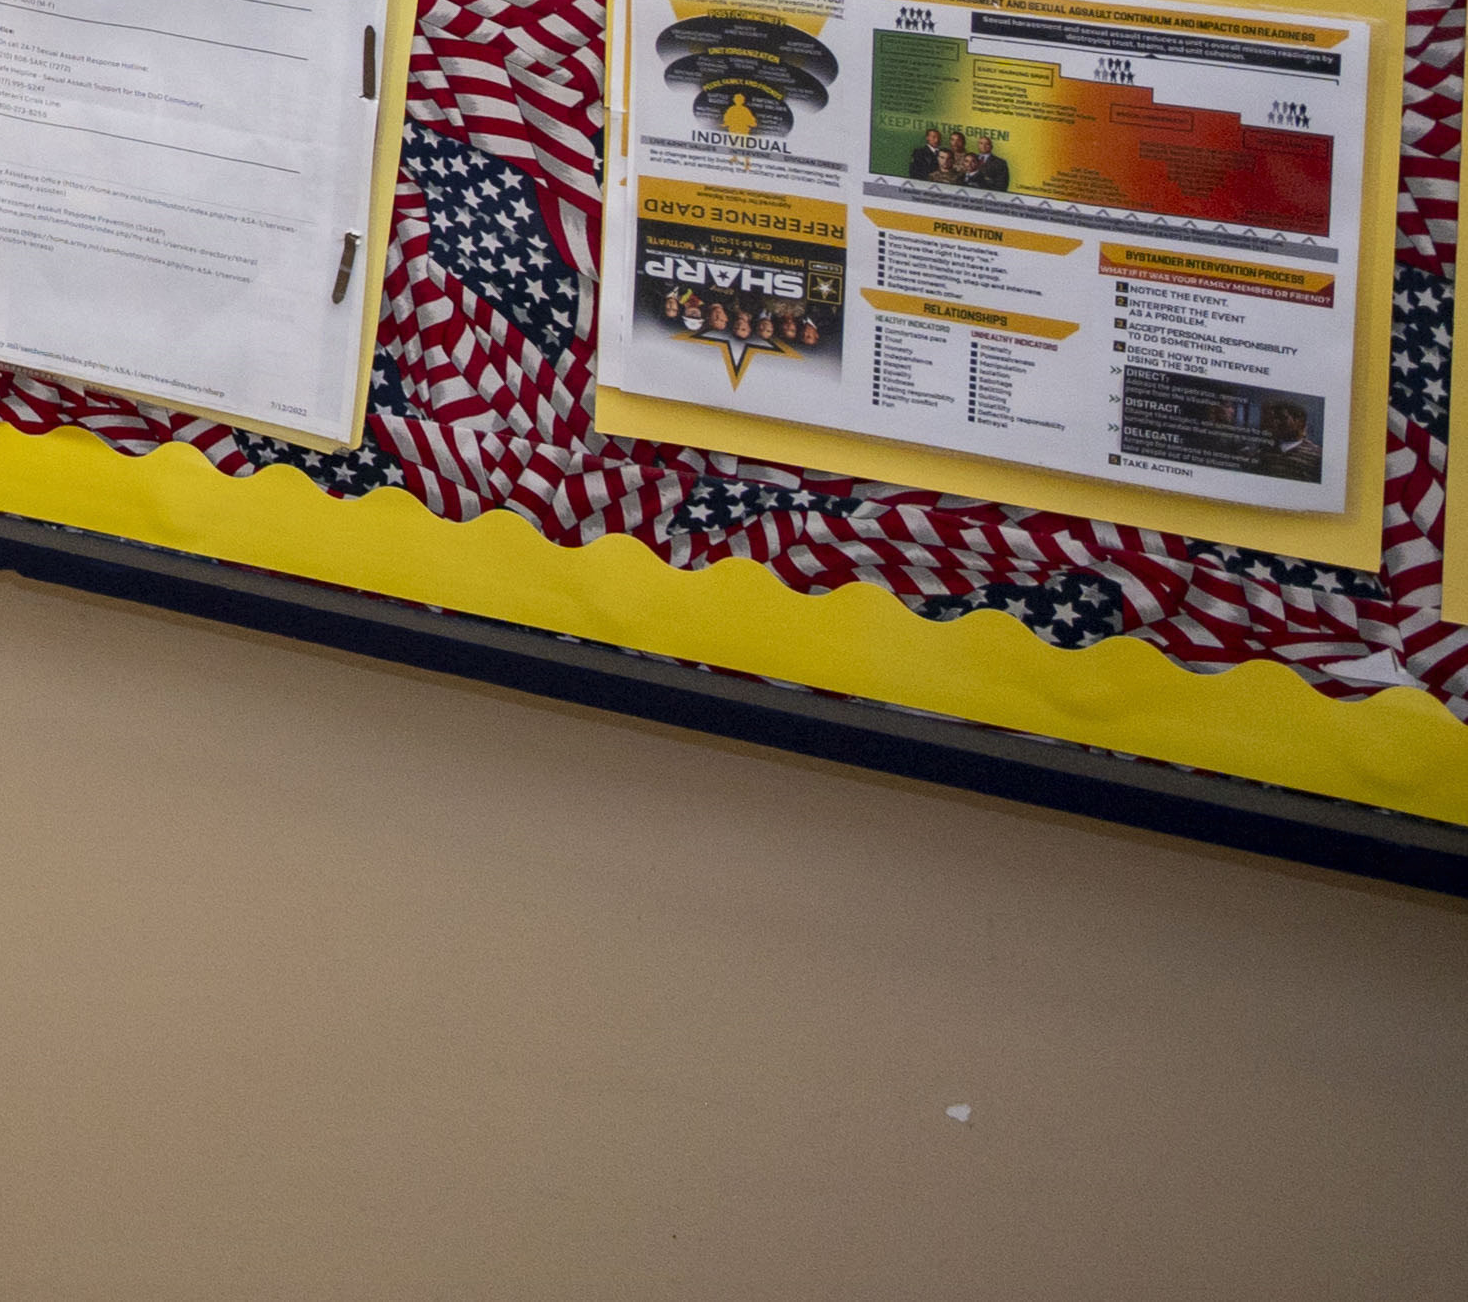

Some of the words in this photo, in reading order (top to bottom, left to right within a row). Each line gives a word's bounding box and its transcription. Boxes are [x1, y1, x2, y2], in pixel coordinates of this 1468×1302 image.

[691, 129, 792, 154] INDIVIDUAL
[644, 199, 706, 218] CARD
[711, 207, 845, 240] REFERENCE
[933, 222, 1004, 242] PREVENTION
[644, 256, 804, 299] SHARP
[1125, 249, 1184, 268] BYSTANDER
[1185, 258, 1257, 278] INTERVENTION
[1258, 269, 1305, 285] PROCESS
[1130, 285, 1168, 299] NOTICE
[1171, 291, 1191, 301] THE
[1193, 294, 1229, 307] EVENT.
[923, 302, 1008, 327] RELATIONSHIPS
[1122, 457, 1148, 470] TAKE
[1150, 462, 1193, 477] ACTION!
